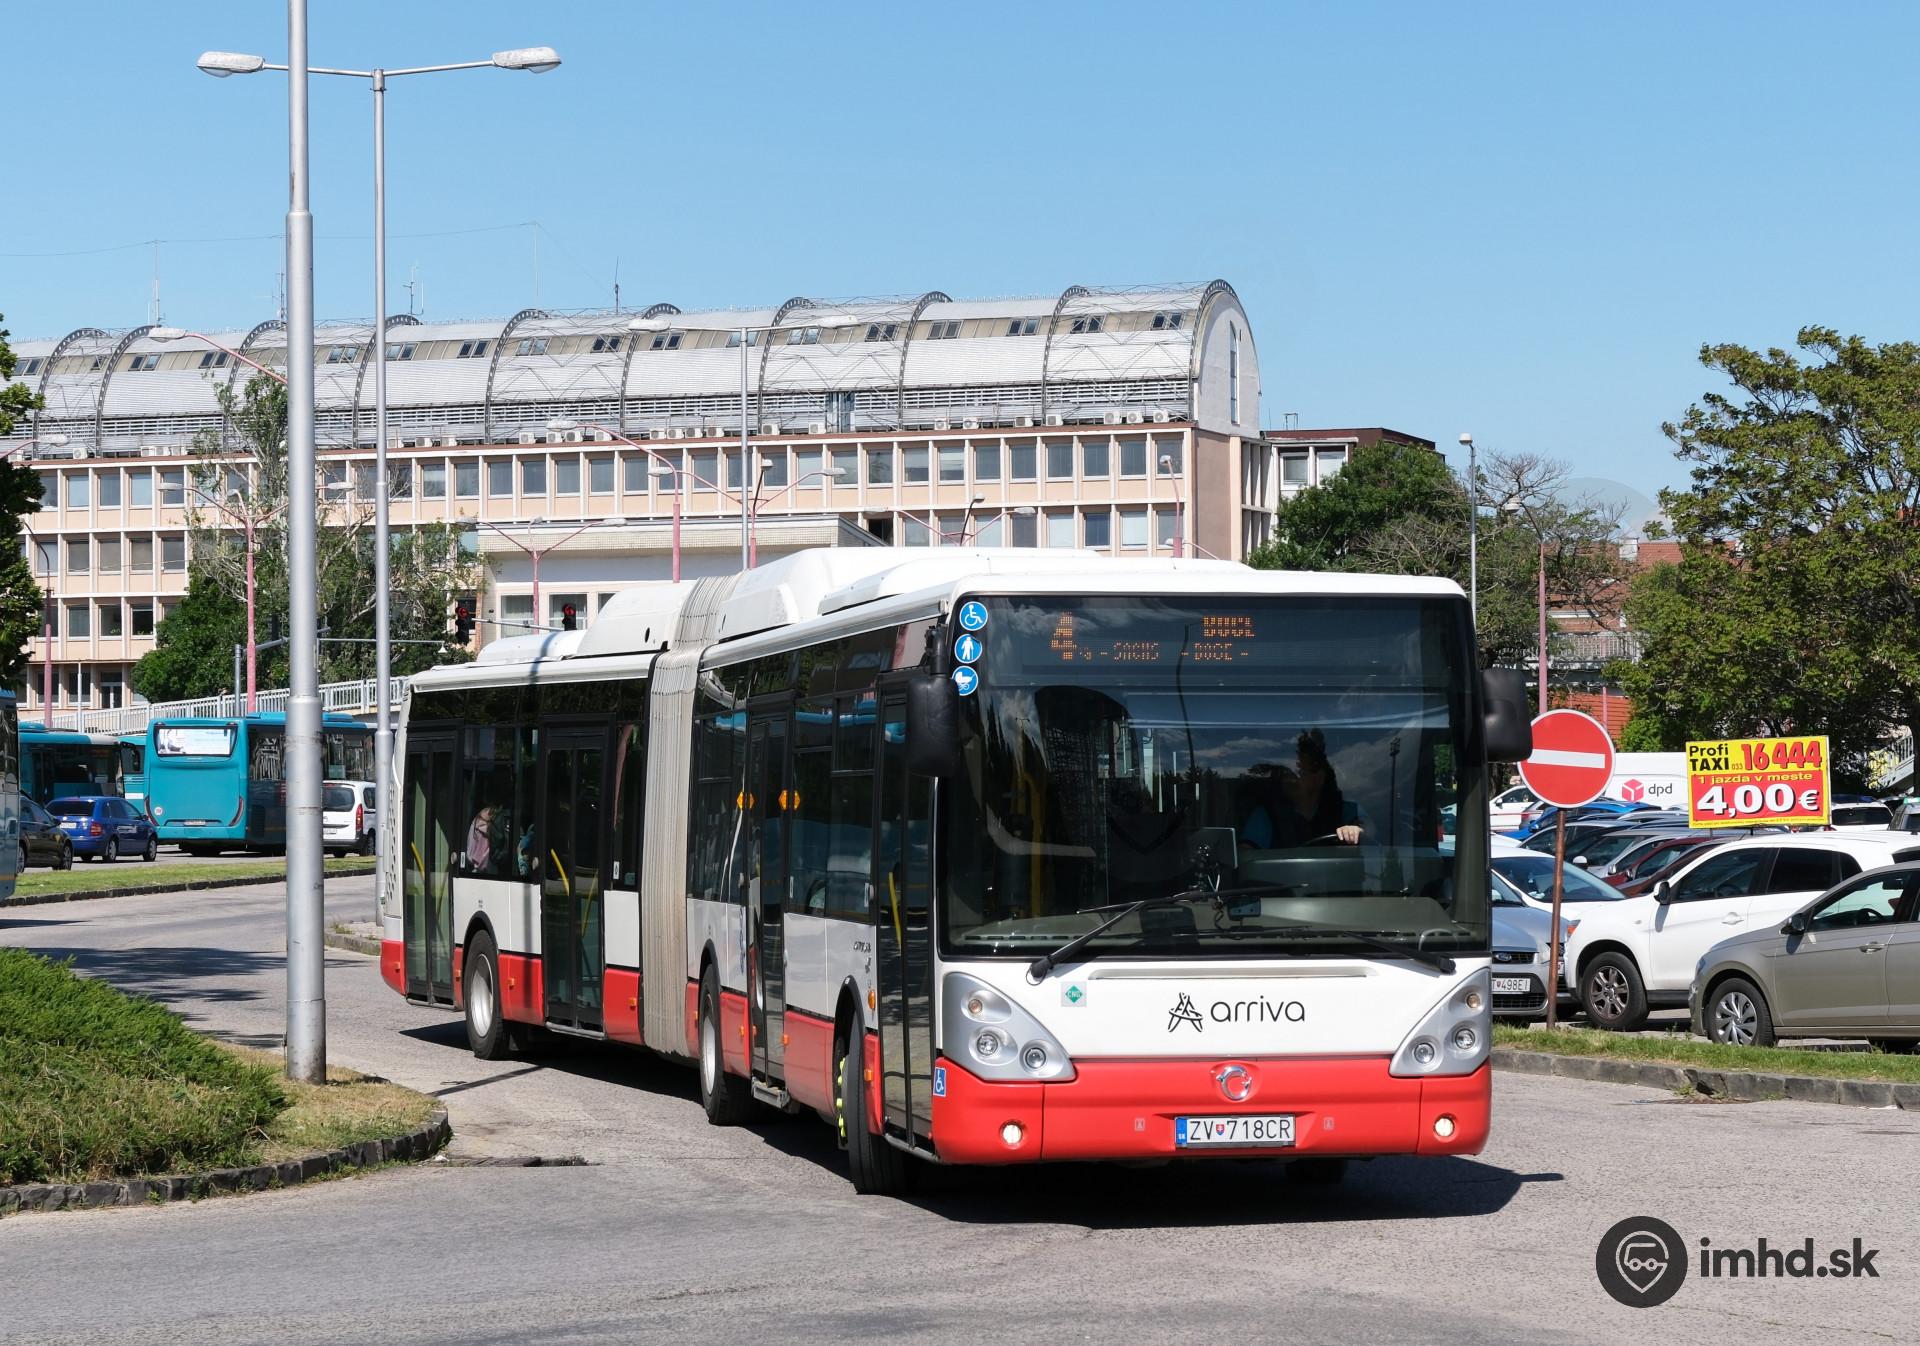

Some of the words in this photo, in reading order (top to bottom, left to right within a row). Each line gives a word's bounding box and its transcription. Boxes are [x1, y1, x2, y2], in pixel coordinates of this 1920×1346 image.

[1051, 610, 1077, 660] 4
[1689, 743, 1729, 757] Profi
[1690, 758, 1729, 771] TAXI
[1731, 762, 1743, 770] 033
[1698, 776, 1706, 784] 1
[1711, 774, 1750, 785] jazda
[1767, 772, 1813, 781] meste
[1648, 783, 1673, 797] dpd
[1210, 995, 1305, 1022] arriva
